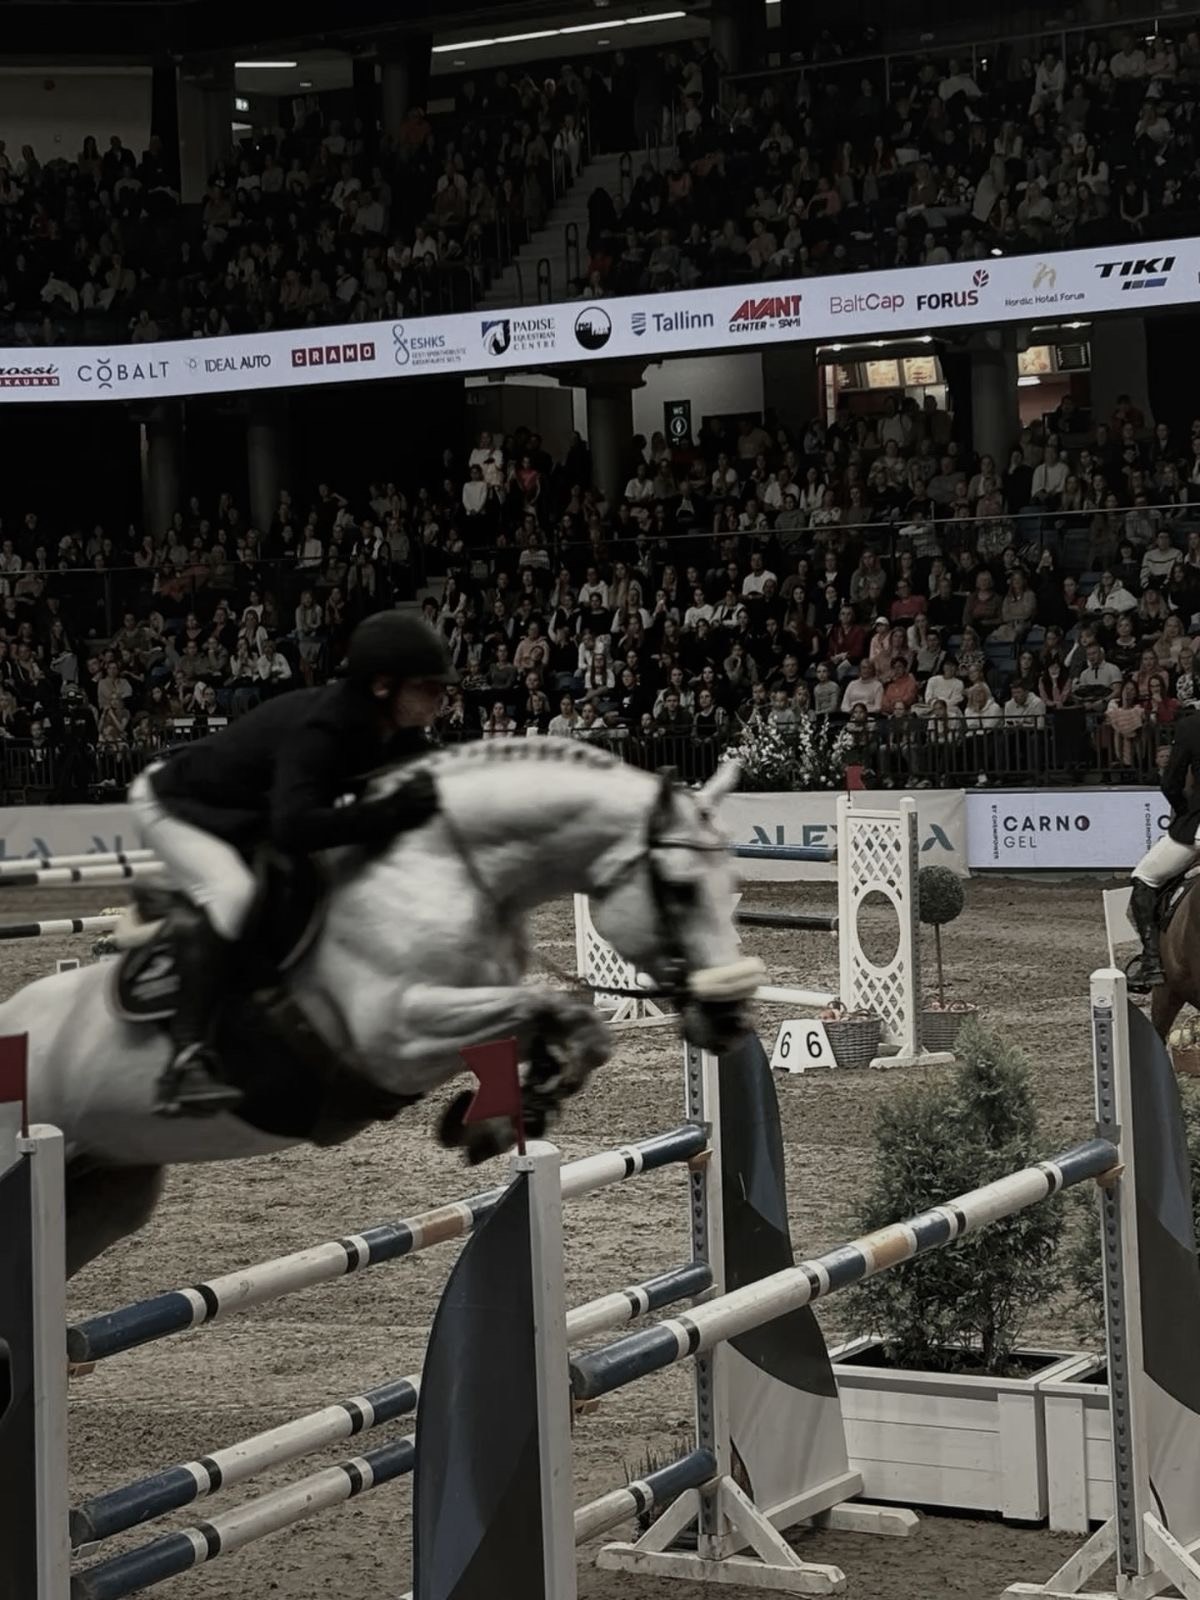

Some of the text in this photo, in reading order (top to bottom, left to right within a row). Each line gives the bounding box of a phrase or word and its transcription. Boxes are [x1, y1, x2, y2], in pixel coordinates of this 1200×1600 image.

[1095, 256, 1176, 278] TIKI
[729, 294, 802, 322] AVANT
[829, 293, 905, 315] BaltCap
[916, 290, 979, 311] FORUS
[1004, 292, 1086, 307] Nordic Hotel Forum
[513, 317, 556, 332] PADISE
[652, 310, 715, 333] Tallinn
[729, 321, 768, 333] CENTER
[411, 335, 446, 350] ESHKS
[204, 354, 272, 373] IDEAL AUTO
[293, 346, 374, 365] CRAMO
[0, 378, 58, 387] KAUBAD
[1003, 815, 1091, 832] CARNO
[1003, 836, 1038, 849] GEL
[780, 1031, 792, 1058] 6
[806, 1031, 823, 1058] 6
